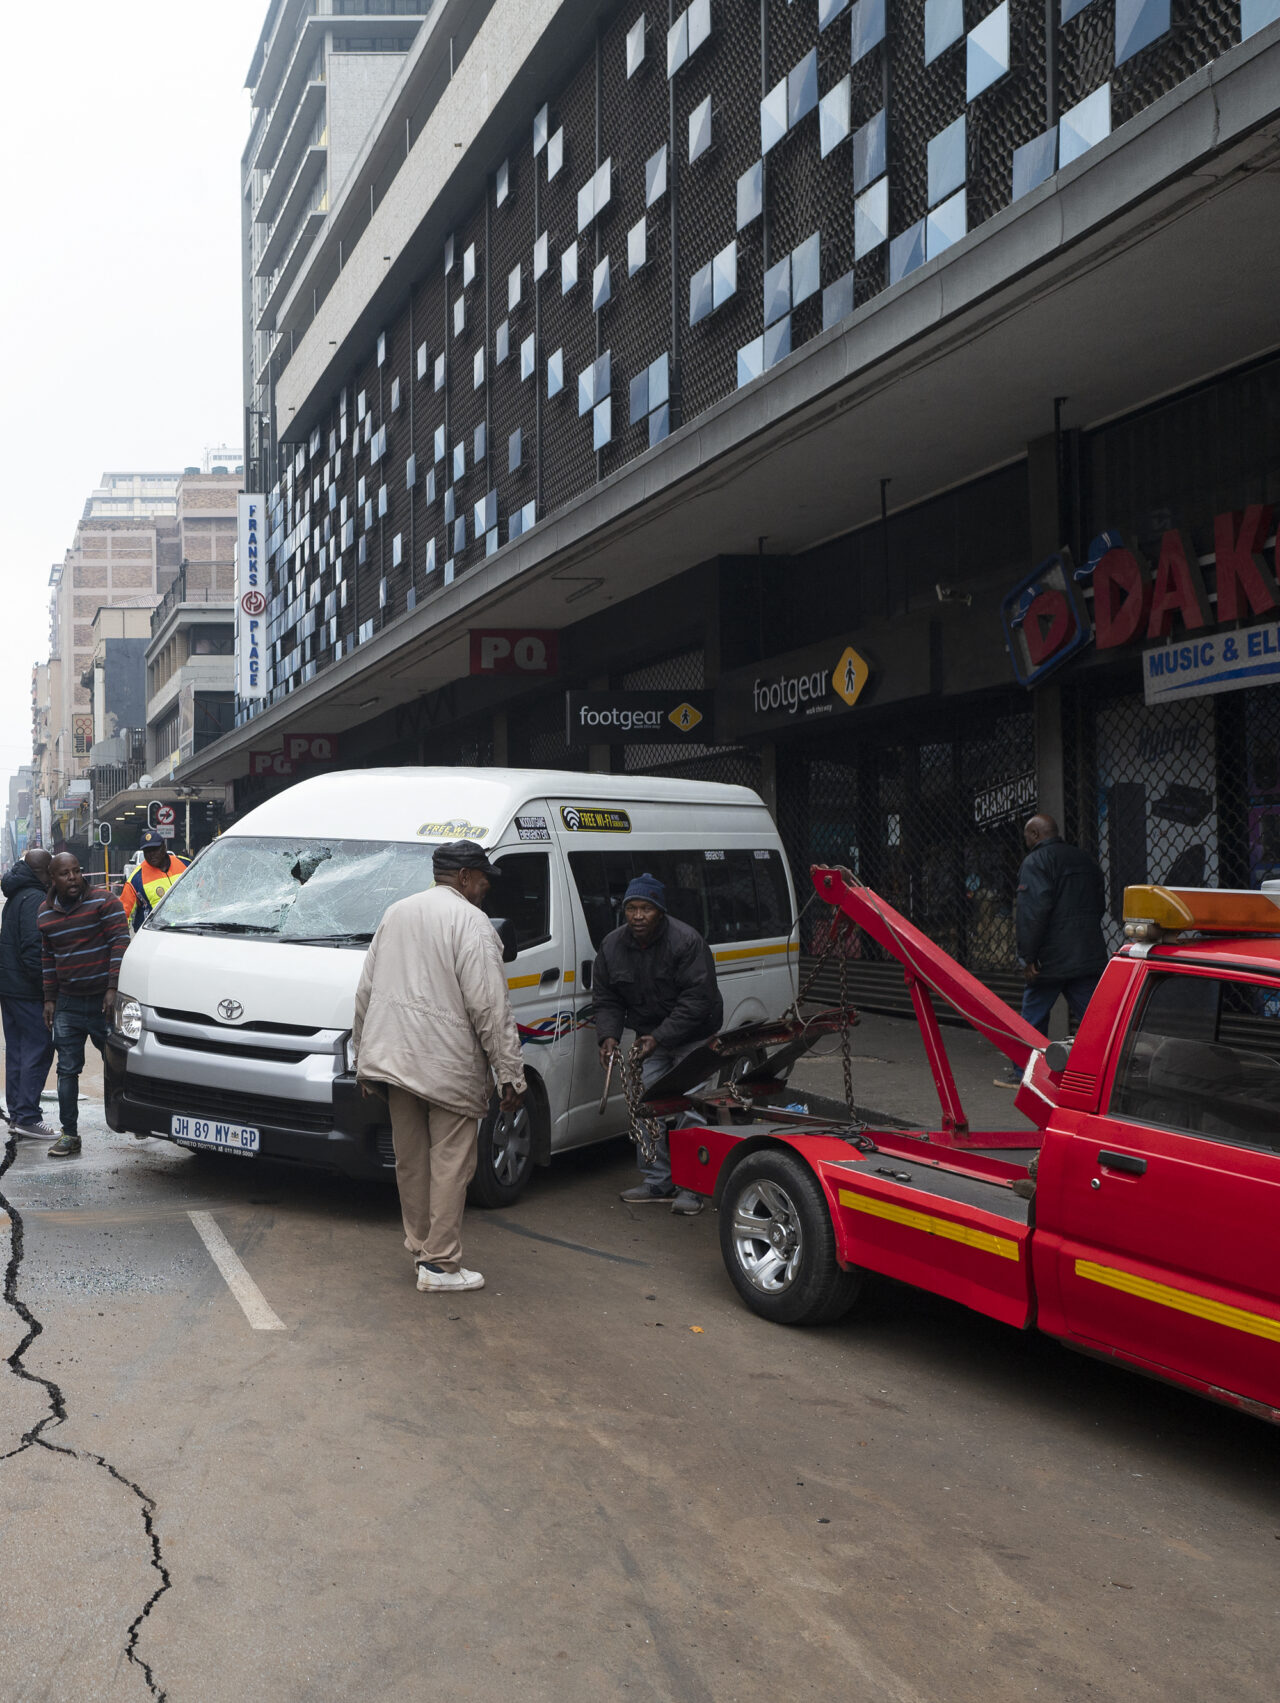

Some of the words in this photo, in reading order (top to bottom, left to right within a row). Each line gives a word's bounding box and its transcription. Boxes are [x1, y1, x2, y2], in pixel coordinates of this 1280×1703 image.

[249, 504, 258, 586] FRANKS
[1093, 504, 1280, 650] DAK
[249, 620, 259, 687] PLACE
[480, 636, 548, 670] PQ
[1149, 641, 1215, 677] MUSIC
[1222, 637, 1239, 662] &
[1247, 628, 1280, 658] EL
[753, 669, 828, 714] footgear
[579, 705, 664, 730] footgear
[290, 738, 332, 759] PQ
[426, 824, 452, 833] FREE
[453, 826, 481, 835] WI-FI
[580, 812, 596, 827] FREE
[597, 813, 613, 828] WI-FI
[174, 1117, 189, 1136] JH
[194, 1121, 209, 1139] 89
[215, 1124, 230, 1143] MY
[241, 1129, 256, 1148] GP
[176, 1138, 197, 1148] SOWETO
[197, 1142, 217, 1152] TOYOTA
